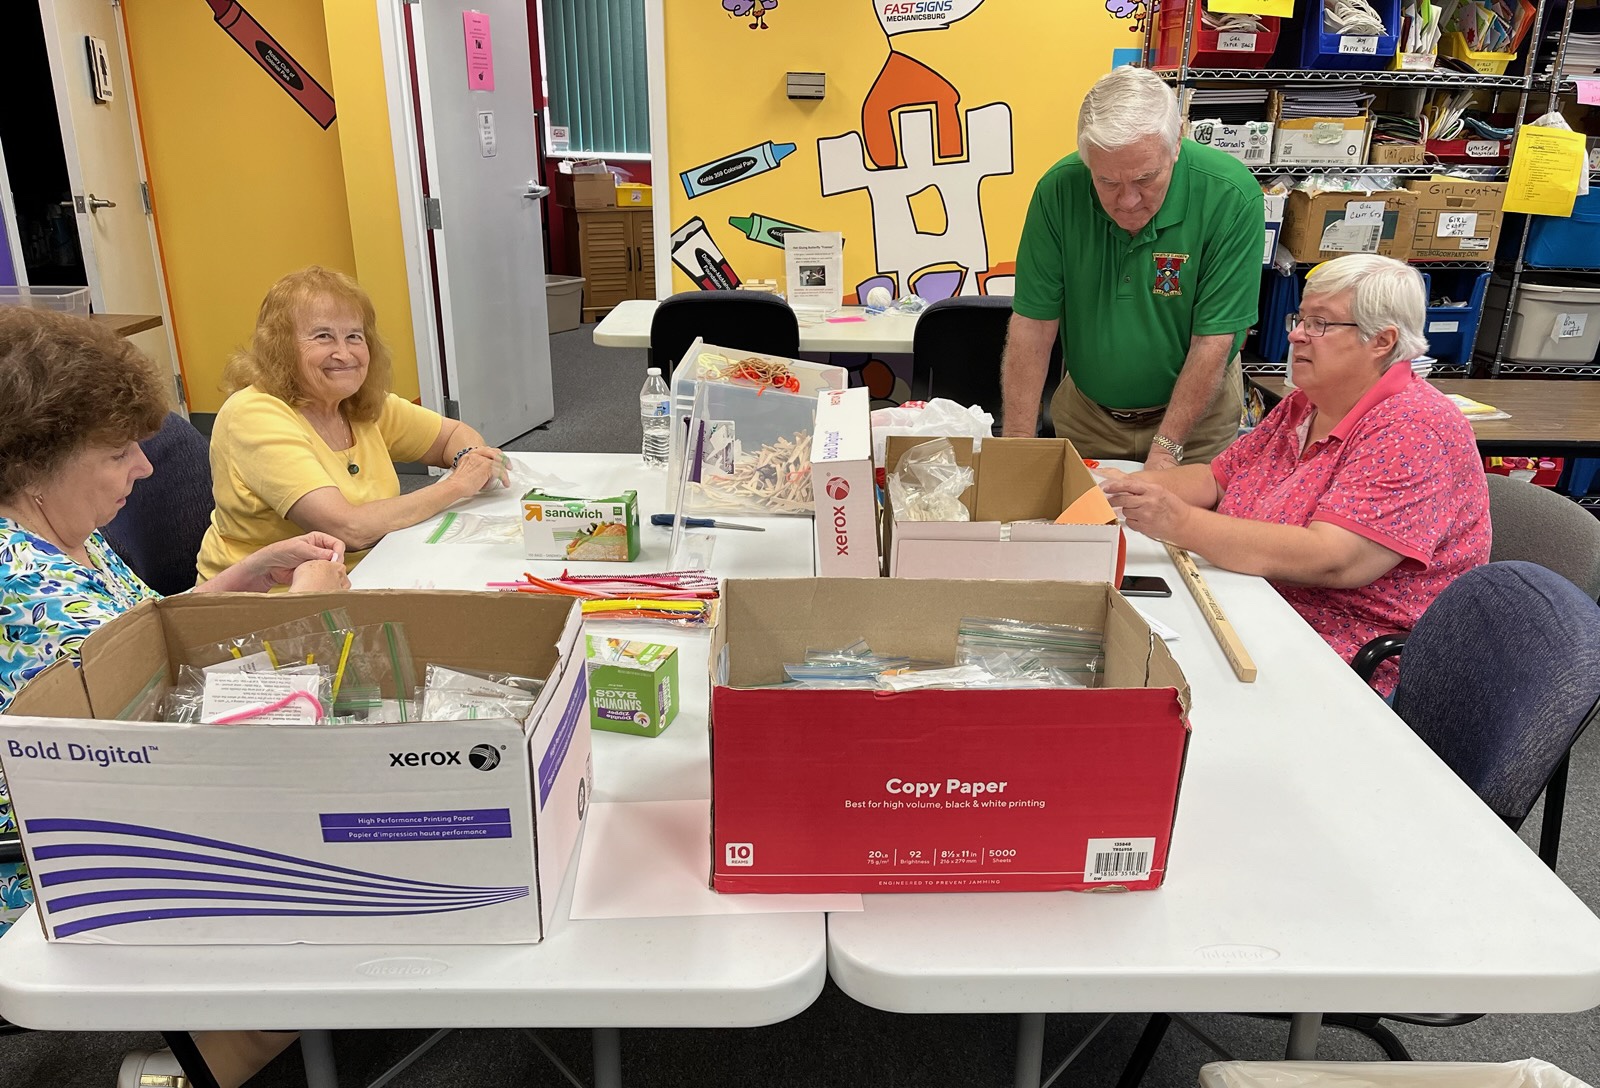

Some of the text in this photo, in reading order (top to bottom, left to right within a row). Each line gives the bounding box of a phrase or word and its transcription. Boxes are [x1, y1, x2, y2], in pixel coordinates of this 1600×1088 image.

[884, 0, 952, 14] FASTSIGNS
[886, 13, 946, 22] MECHANICSBURG
[265, 55, 290, 80] Colonial Park
[268, 50, 281, 64] Rotary
[280, 62, 290, 73] Club
[1223, 127, 1237, 135] Boy
[1214, 138, 1245, 148] Journals
[700, 175, 714, 183] Kohls
[724, 164, 743, 174] Colonial
[1429, 184, 1454, 194] Girl
[703, 264, 722, 289] Foundation
[545, 509, 603, 519] sandwich
[833, 505, 849, 556] xerox
[595, 689, 637, 699] BAGS
[593, 697, 642, 710] SANDWICH
[8, 740, 61, 760] Bold
[389, 750, 462, 767] xerox
[886, 778, 1008, 798] Copy Paper
[845, 800, 866, 808] Best
[868, 800, 882, 808] for
[883, 800, 904, 810] high
[906, 800, 943, 810] volume,
[945, 800, 971, 808] black
[980, 799, 1007, 808] white
[1008, 799, 1046, 809] printing
[373, 830, 418, 839] d'impression
[442, 828, 487, 836] performance
[729, 846, 750, 859] 10
